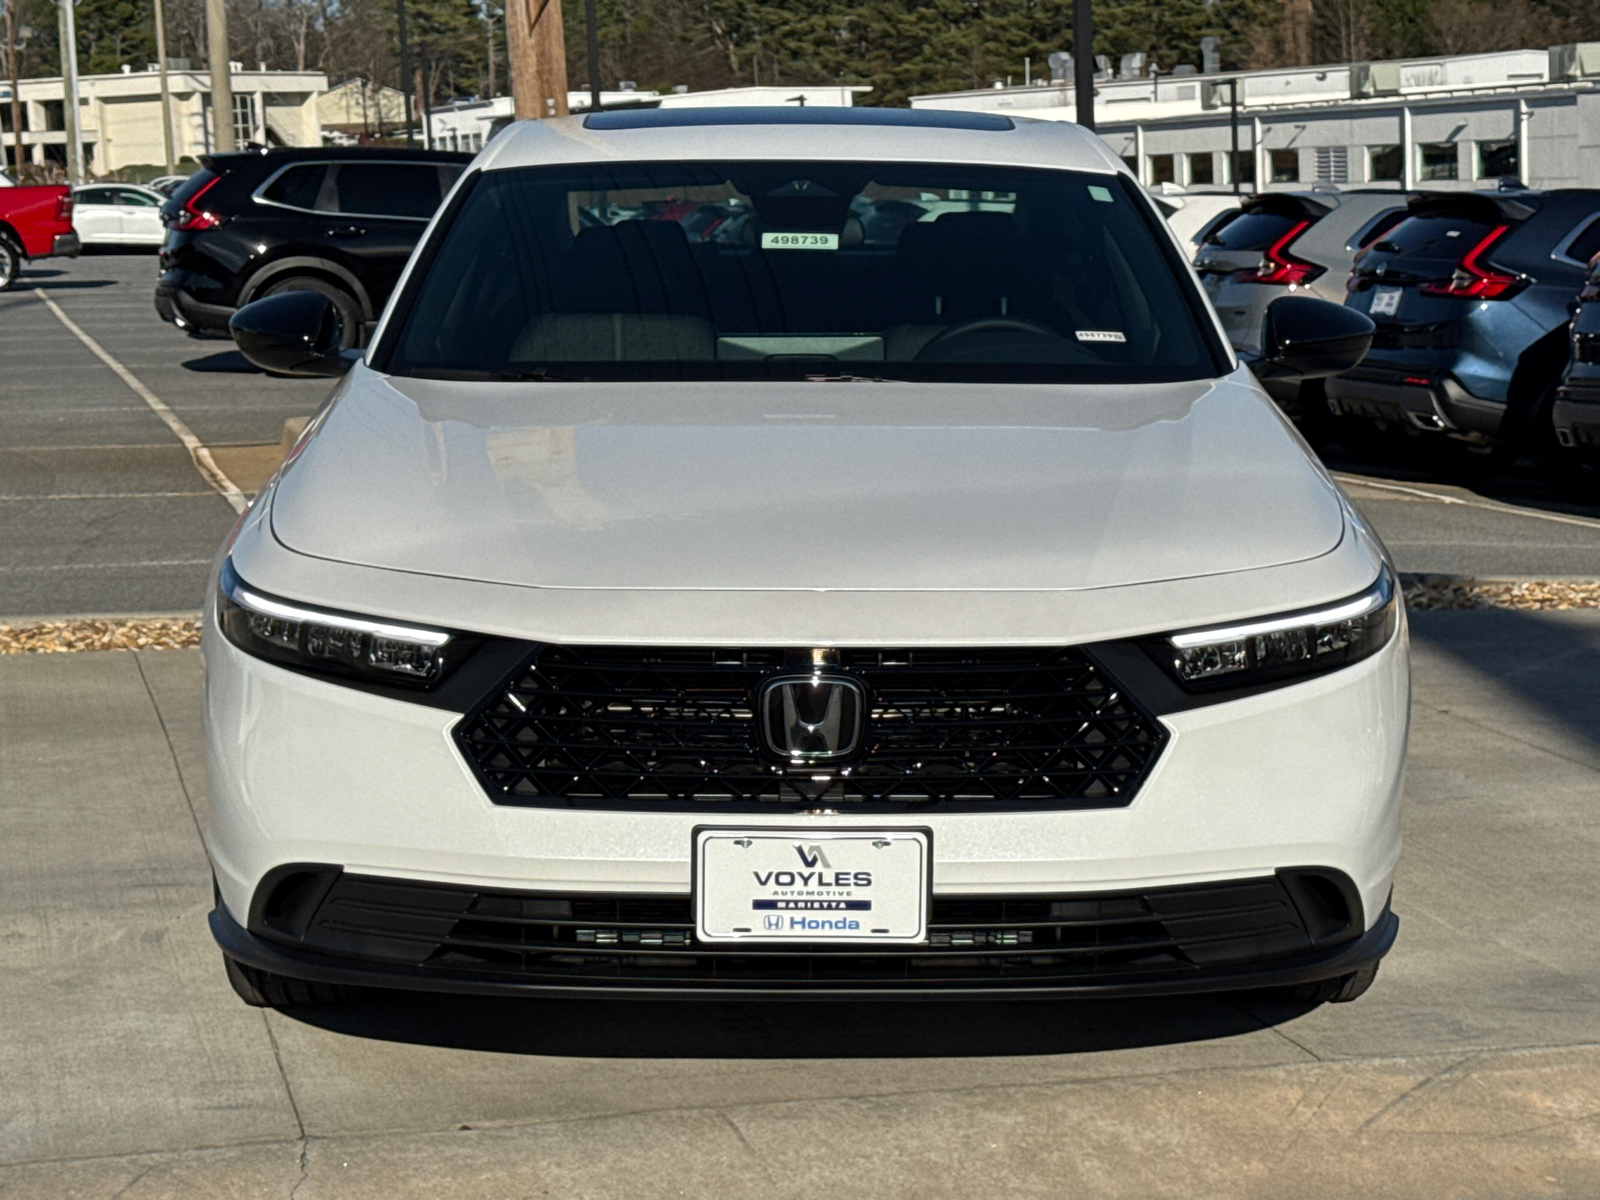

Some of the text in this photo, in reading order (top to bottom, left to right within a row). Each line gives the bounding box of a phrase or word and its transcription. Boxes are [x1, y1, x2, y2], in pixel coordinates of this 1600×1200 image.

[770, 235, 829, 245] 498739
[752, 871, 873, 887] VOYLES
[777, 901, 847, 909] MARIETTA
[789, 916, 860, 930] Honda
